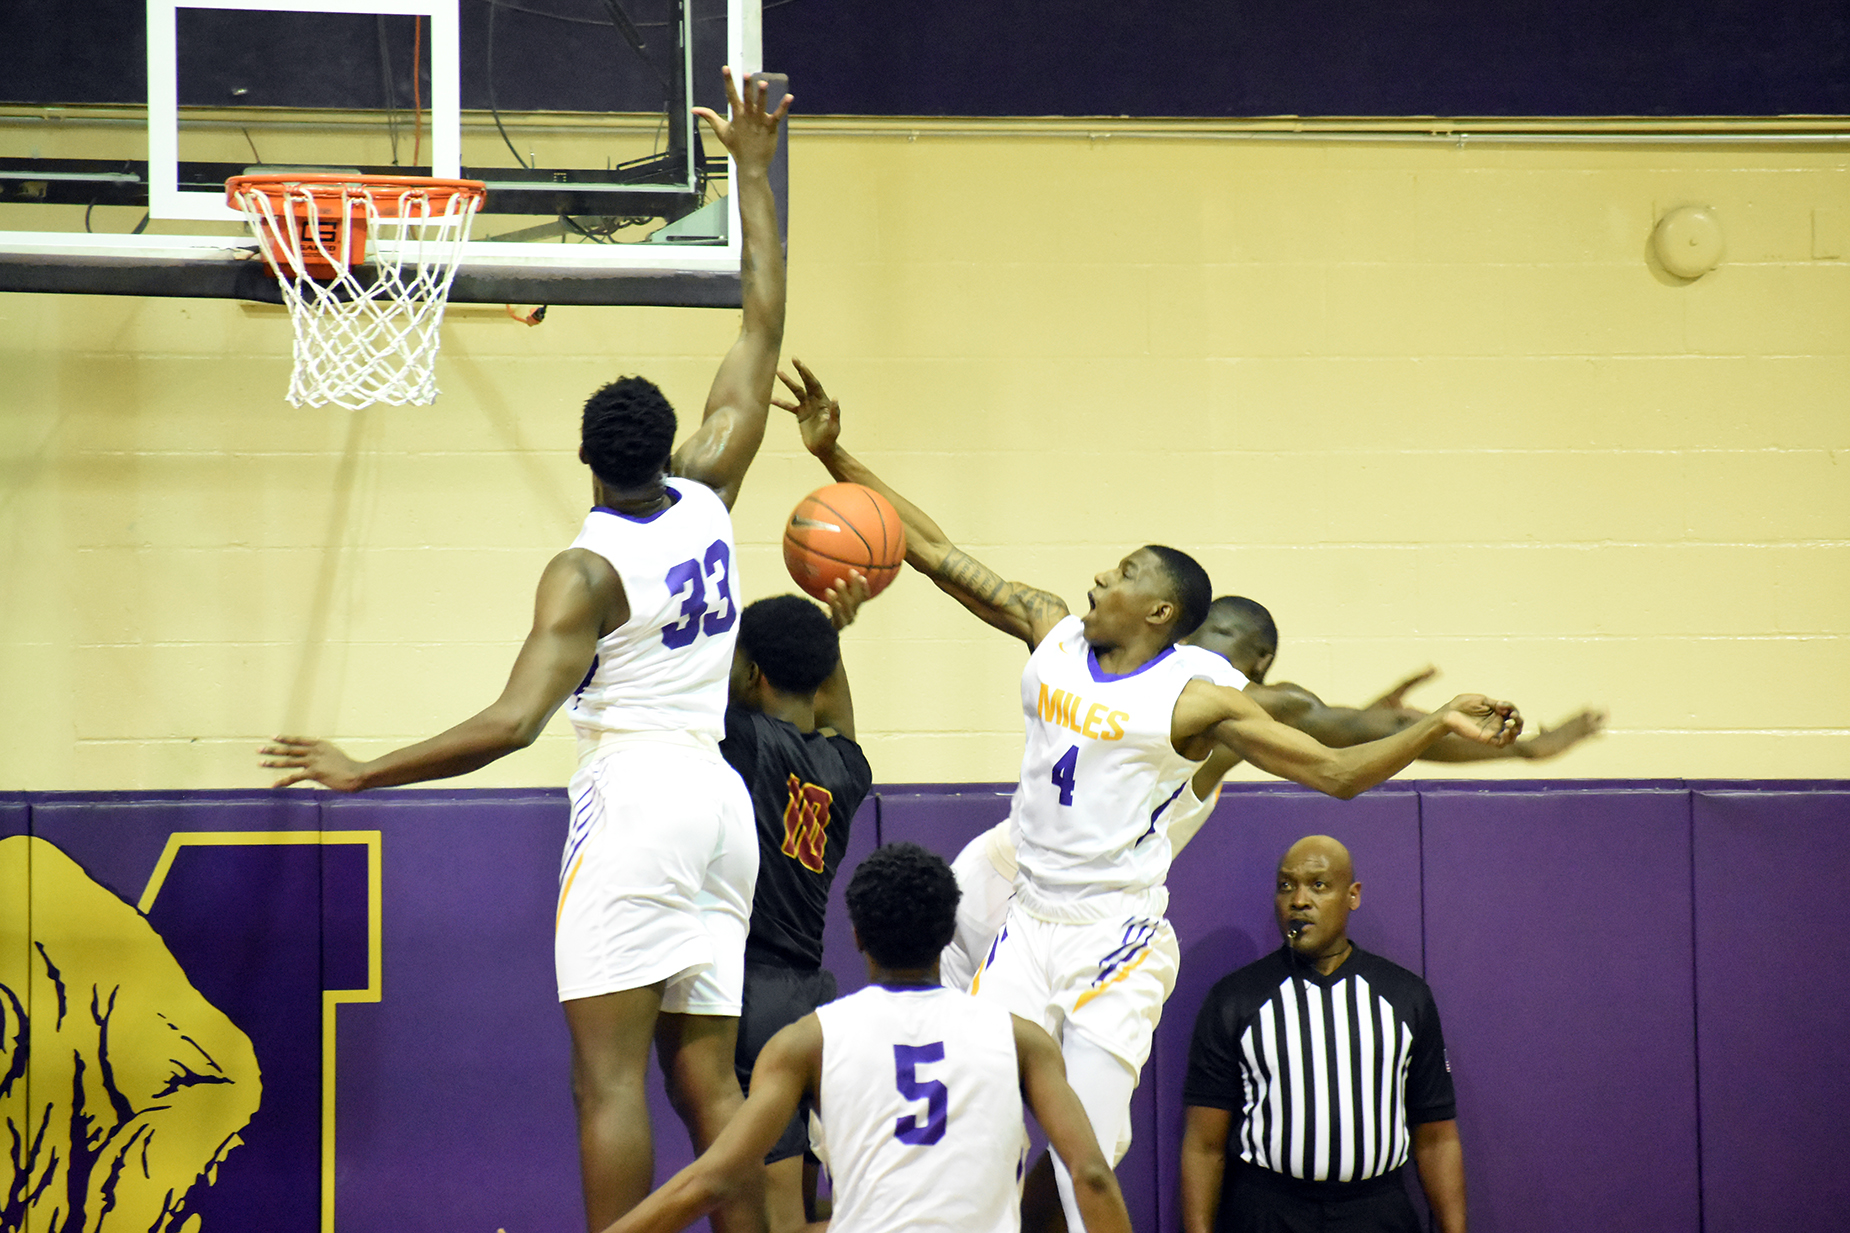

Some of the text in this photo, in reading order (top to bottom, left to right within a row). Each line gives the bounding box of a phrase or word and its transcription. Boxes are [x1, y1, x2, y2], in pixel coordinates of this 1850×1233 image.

[662, 540, 736, 649] 33
[1037, 682, 1130, 741] MILES
[780, 773, 834, 873] 10
[1051, 744, 1079, 807] 4
[893, 1041, 948, 1146] 5
